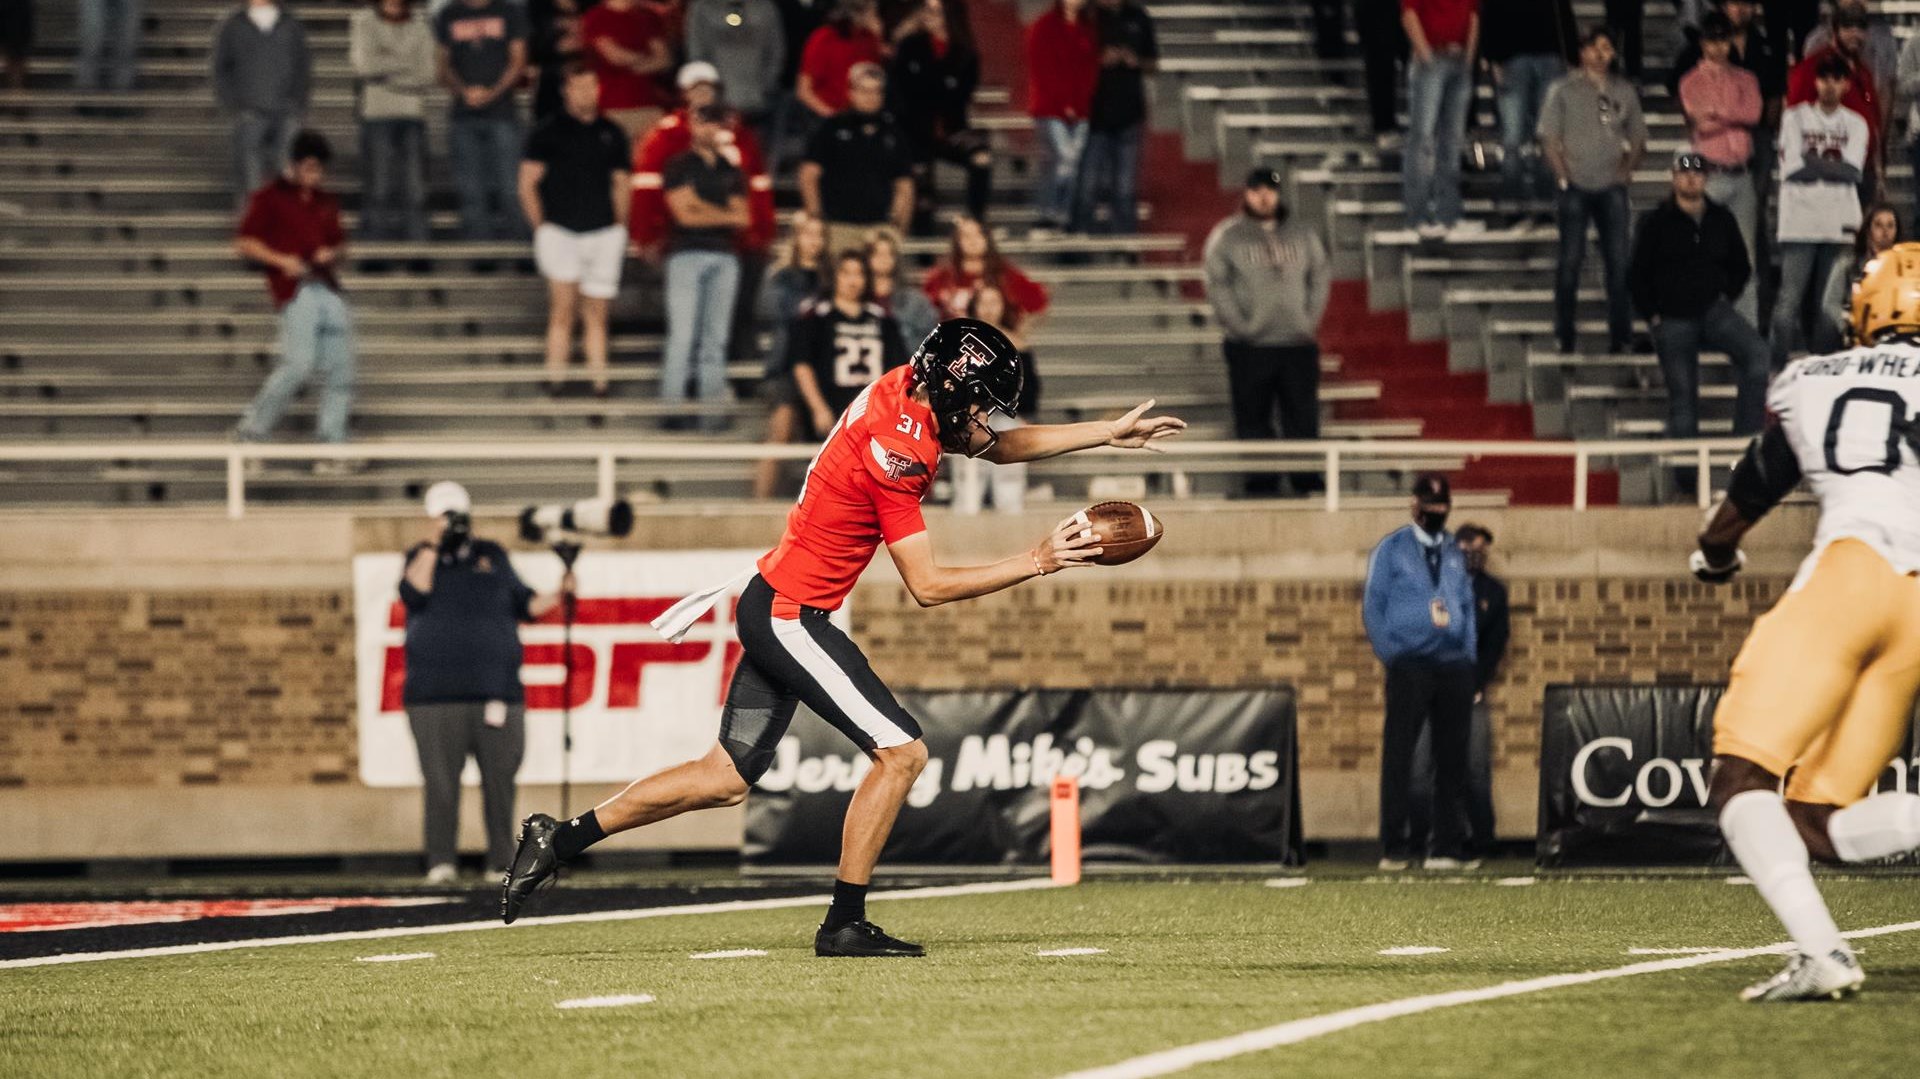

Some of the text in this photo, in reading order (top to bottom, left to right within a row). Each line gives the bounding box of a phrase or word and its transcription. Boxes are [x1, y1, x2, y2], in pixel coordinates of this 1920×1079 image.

[833, 336, 884, 388] 23
[896, 412, 923, 442] 31
[950, 731, 1127, 792] Mike's
